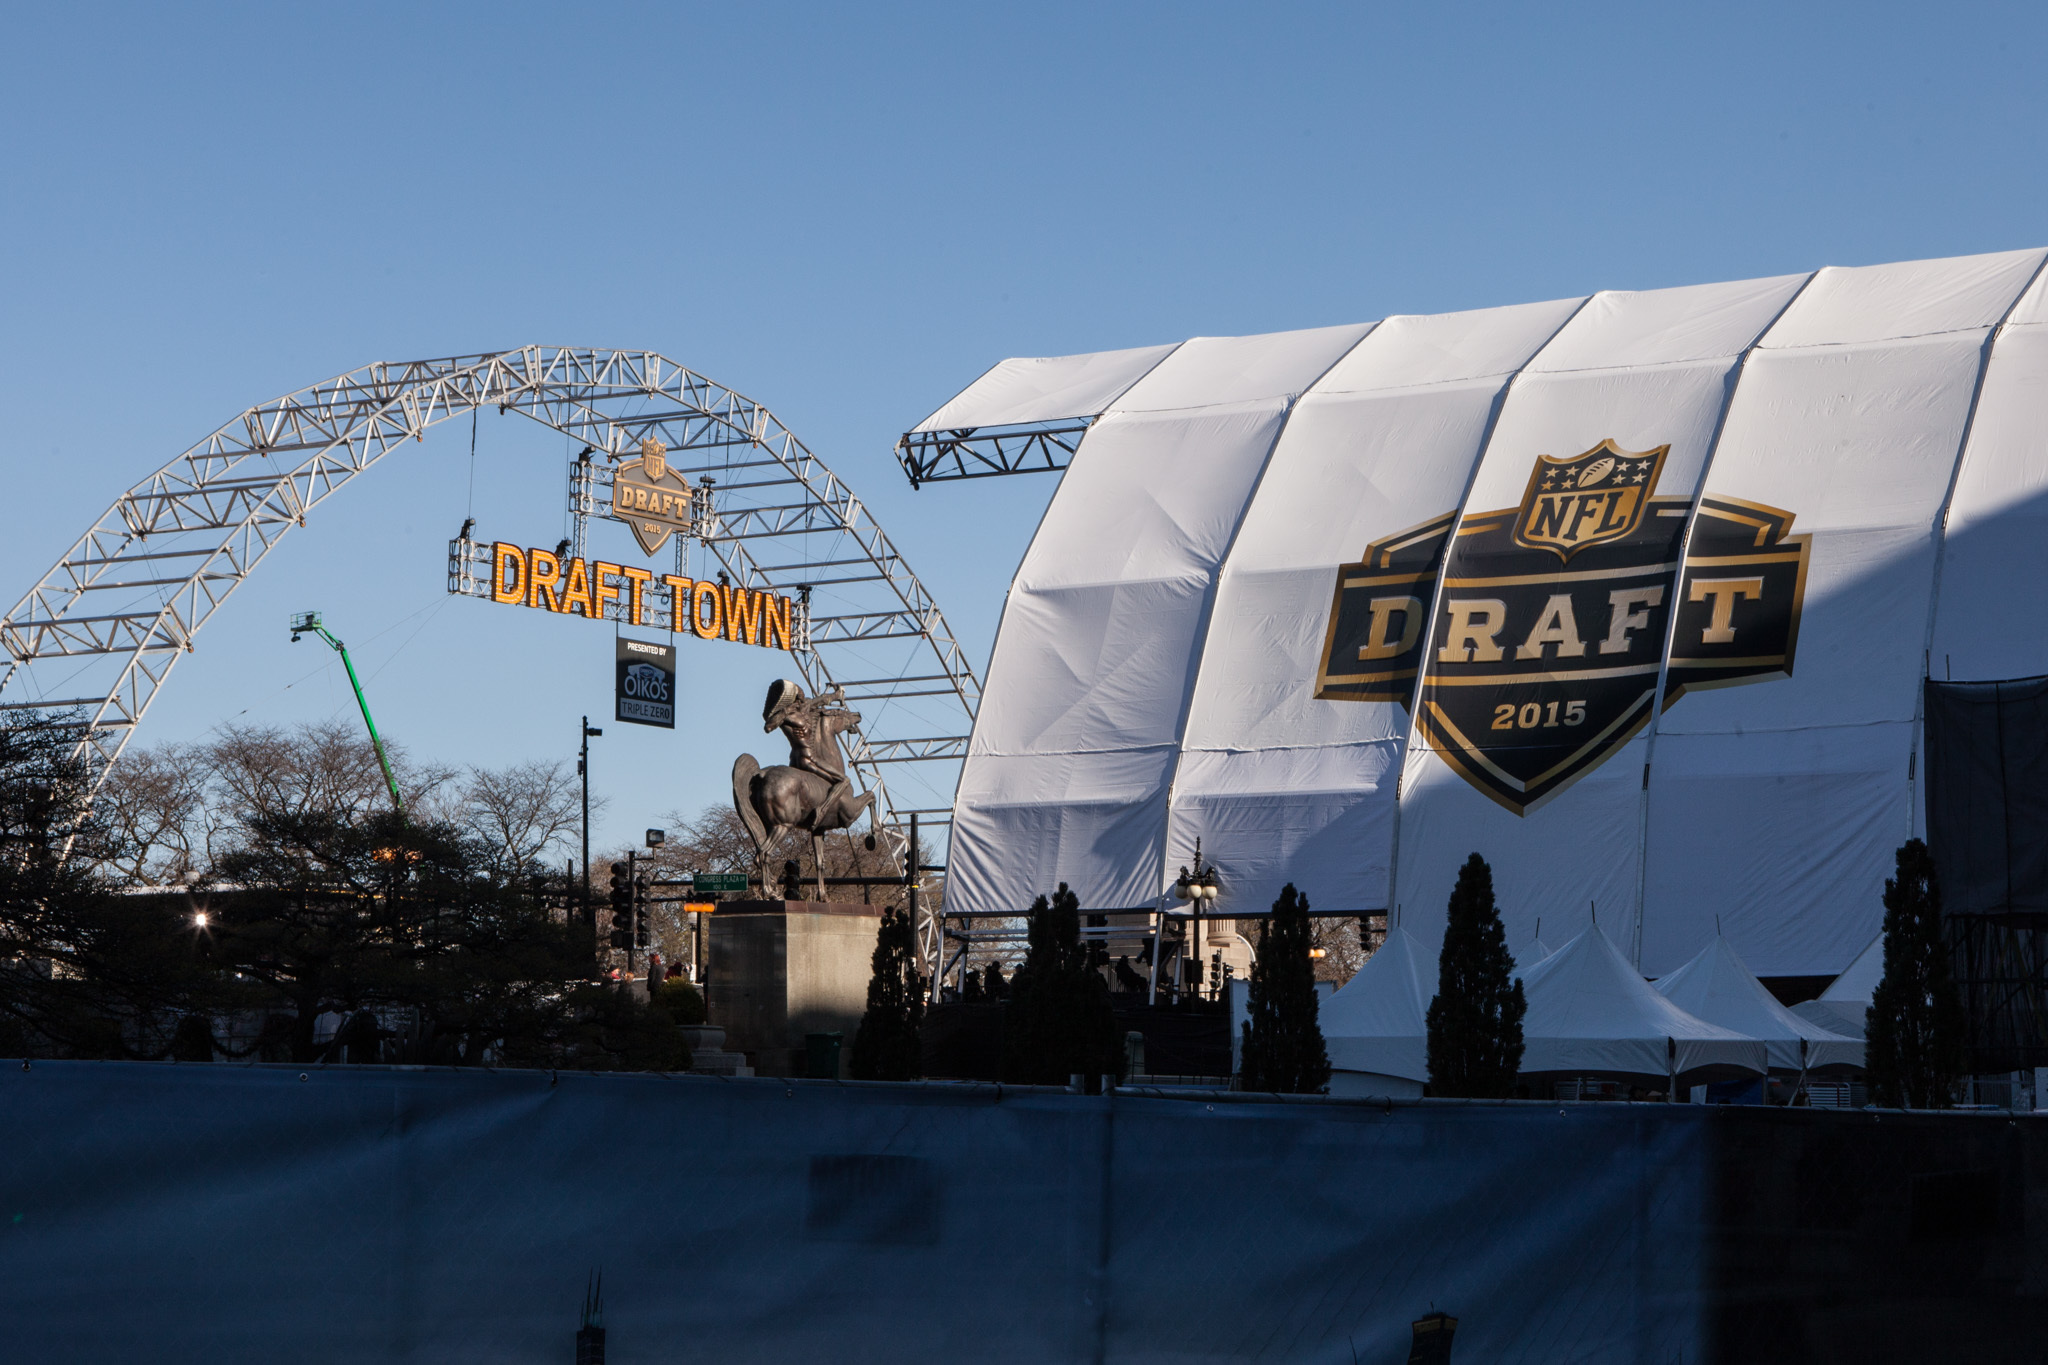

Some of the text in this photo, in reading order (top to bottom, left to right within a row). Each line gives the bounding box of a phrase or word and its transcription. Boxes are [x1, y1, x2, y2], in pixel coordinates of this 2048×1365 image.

[647, 456, 665, 476] NFL
[621, 485, 687, 519] DRAFT
[644, 522, 661, 534] 2015
[1528, 490, 1629, 541] NFL
[491, 541, 792, 651] DRAFT TOWN
[1357, 576, 1765, 664] DRAFT
[627, 642, 667, 656] PRESENTED BY
[624, 675, 668, 701] OIKOS
[622, 702, 670, 719] TRIPLE ZERO
[1491, 700, 1587, 731] 2015
[699, 875, 721, 883] CONGRESS
[724, 875, 739, 883] PLAZA
